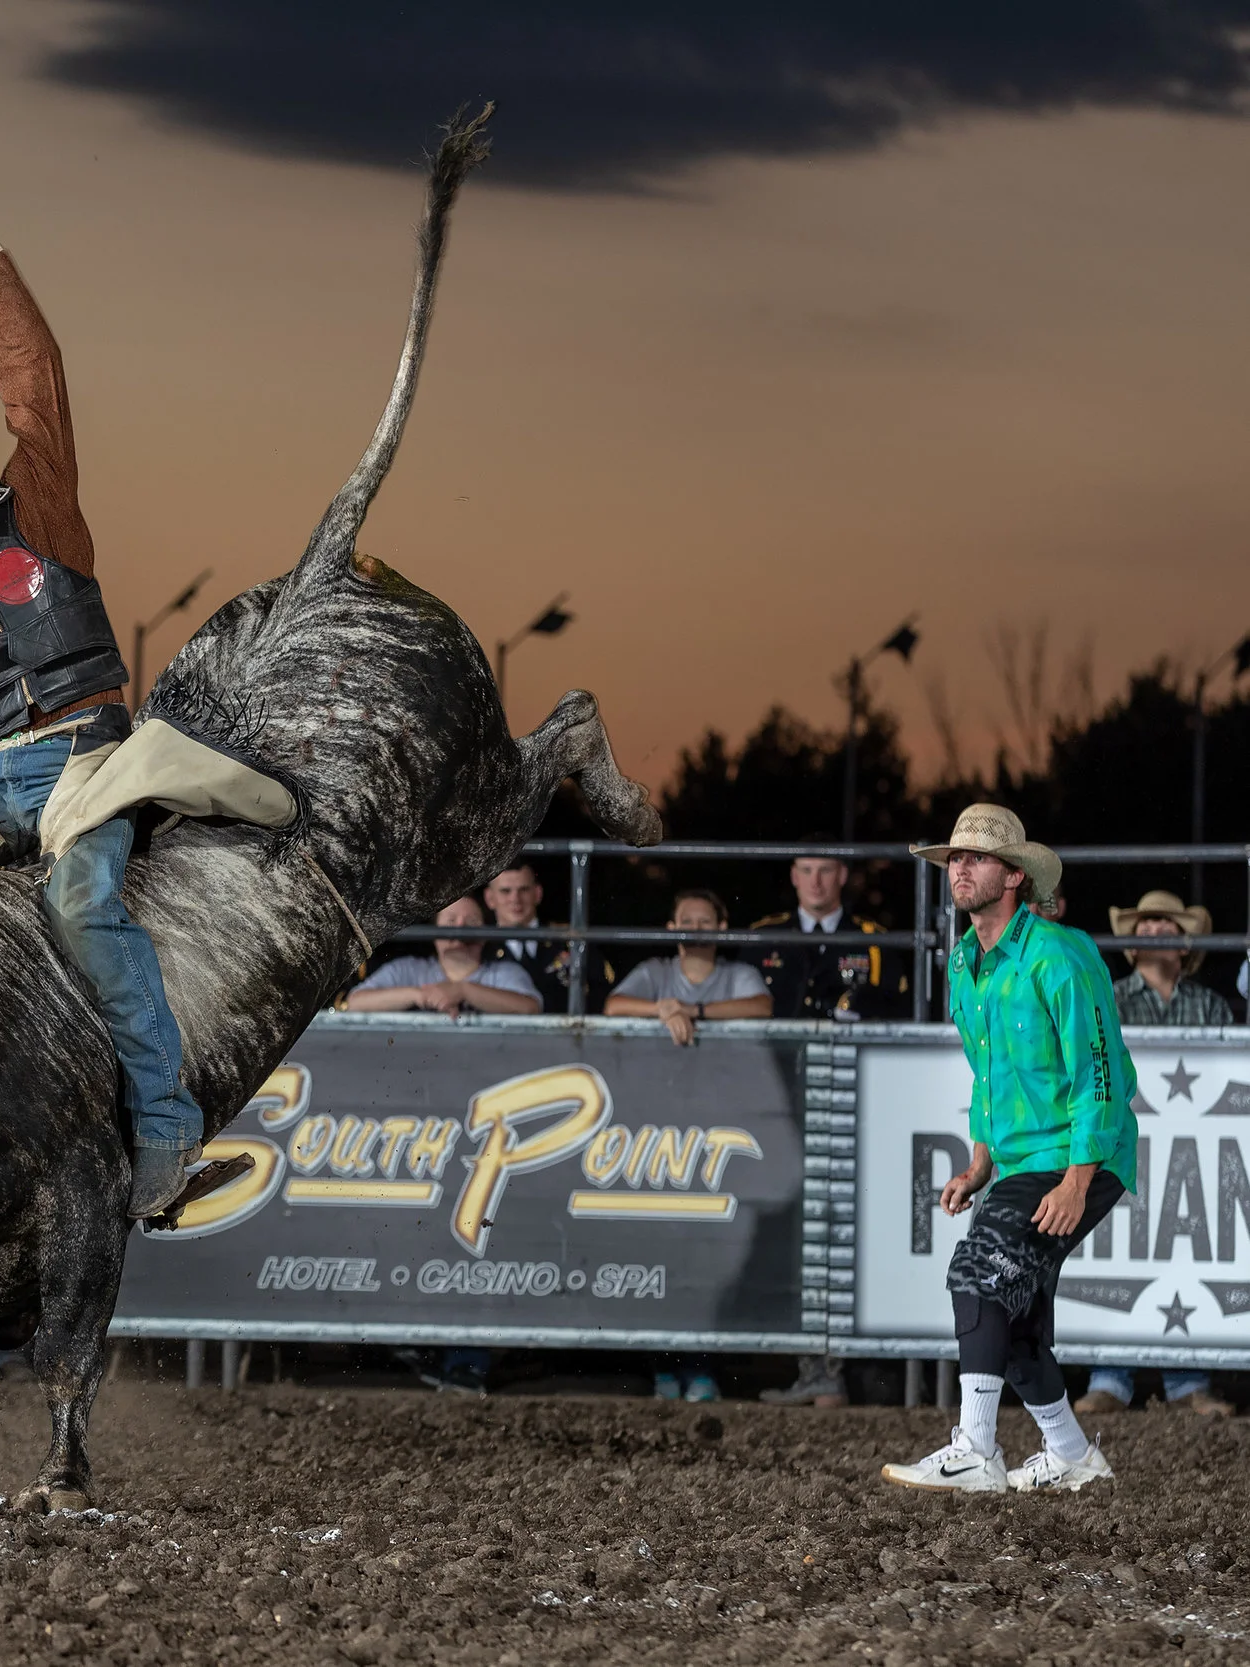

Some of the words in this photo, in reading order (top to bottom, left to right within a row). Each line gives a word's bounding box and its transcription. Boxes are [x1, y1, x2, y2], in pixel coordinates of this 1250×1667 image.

[1090, 1041, 1104, 1102] JEANS
[1094, 1006, 1112, 1102] CINCH
[451, 1062, 764, 1257] POINT
[257, 1256, 381, 1293] HOTEL
[417, 1259, 564, 1297] CASINO
[591, 1264, 666, 1300] SPA
